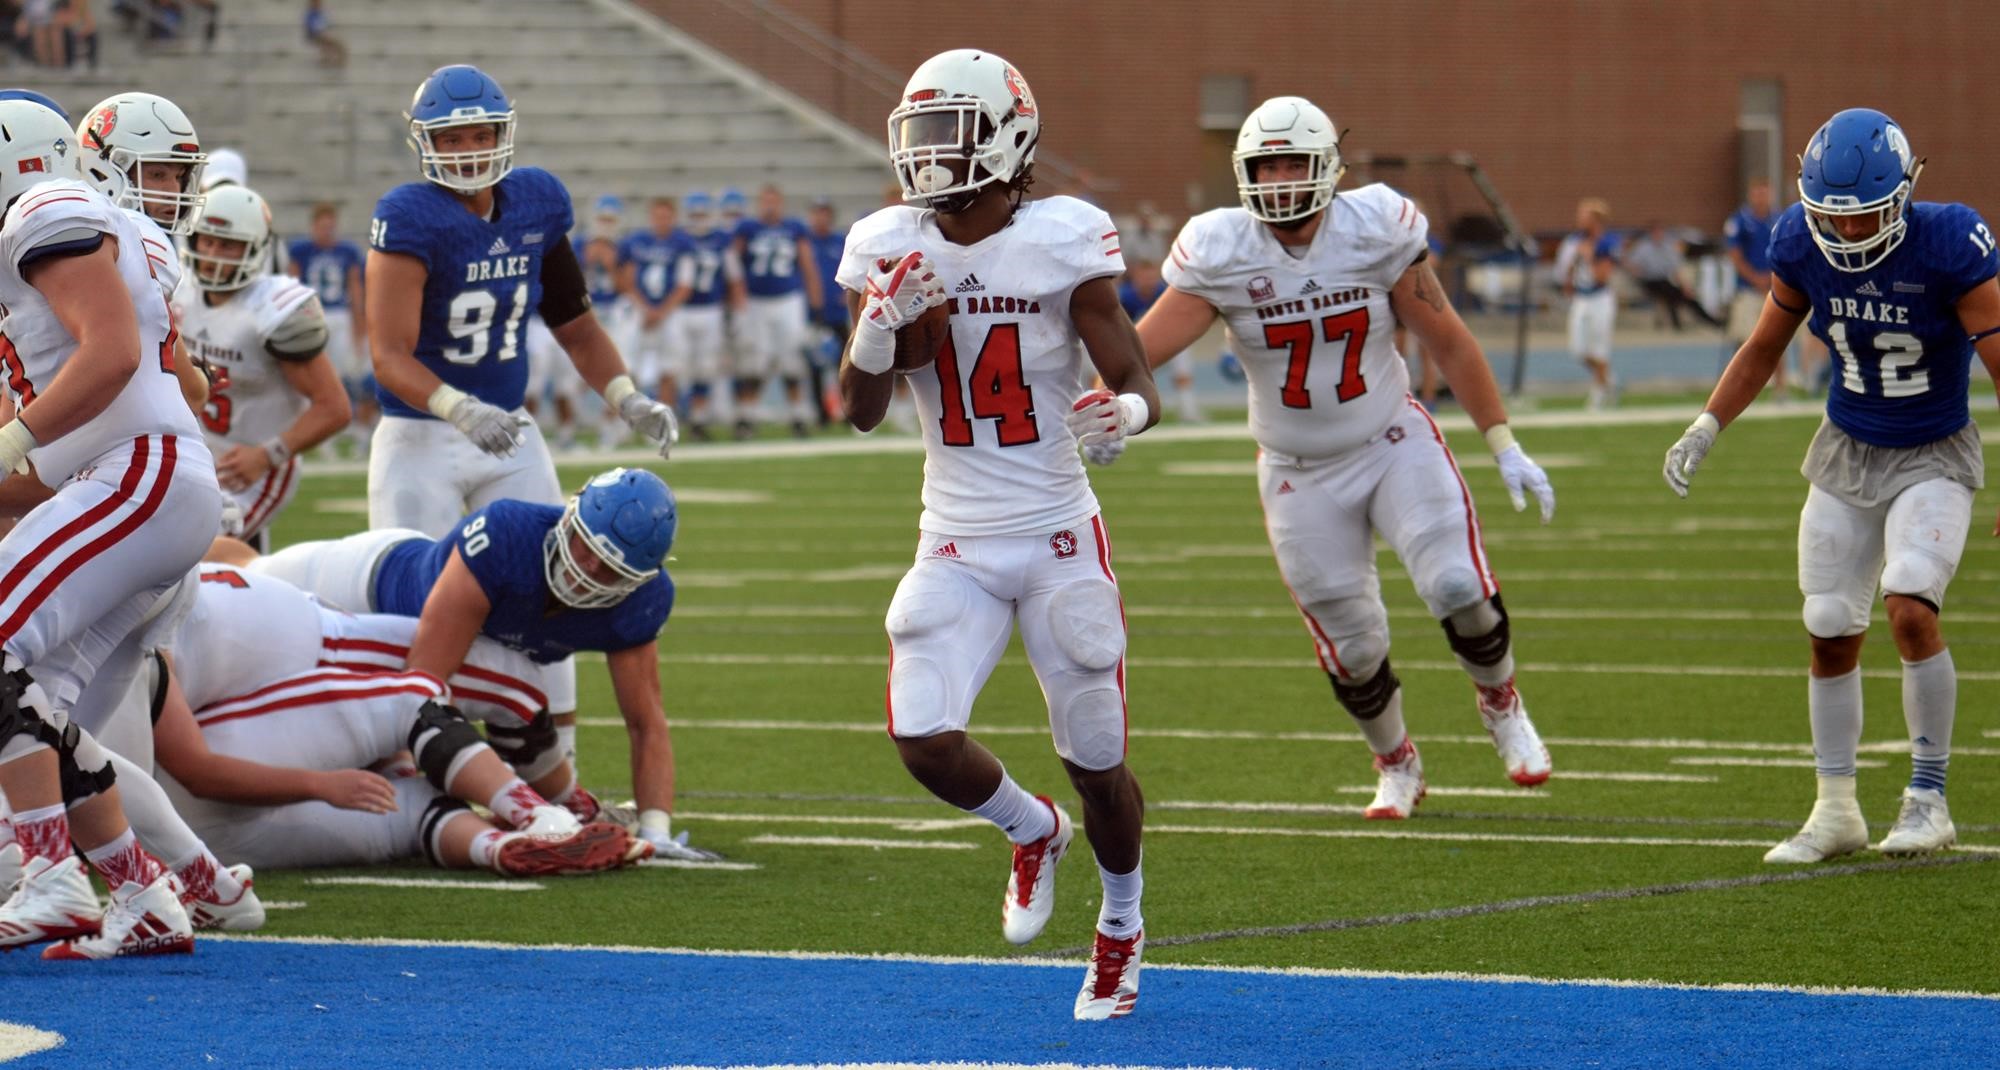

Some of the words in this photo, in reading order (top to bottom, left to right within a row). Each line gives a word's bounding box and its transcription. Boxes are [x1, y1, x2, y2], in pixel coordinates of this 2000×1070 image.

[370, 218, 388, 248] 91
[1969, 222, 1996, 258] 12
[465, 256, 530, 282] DRAKE
[955, 283, 986, 293] adidas
[1257, 300, 1305, 320] SOUTH
[1311, 288, 1370, 311] DAKOTA
[968, 297, 1041, 314] DAKOTA
[1830, 297, 1909, 325] DRAKE
[443, 283, 528, 364] 91
[1263, 305, 1370, 409] 77
[1828, 321, 1931, 398] 12
[934, 322, 1040, 447] 14
[462, 516, 490, 558] 90
[115, 931, 185, 957] adidas
